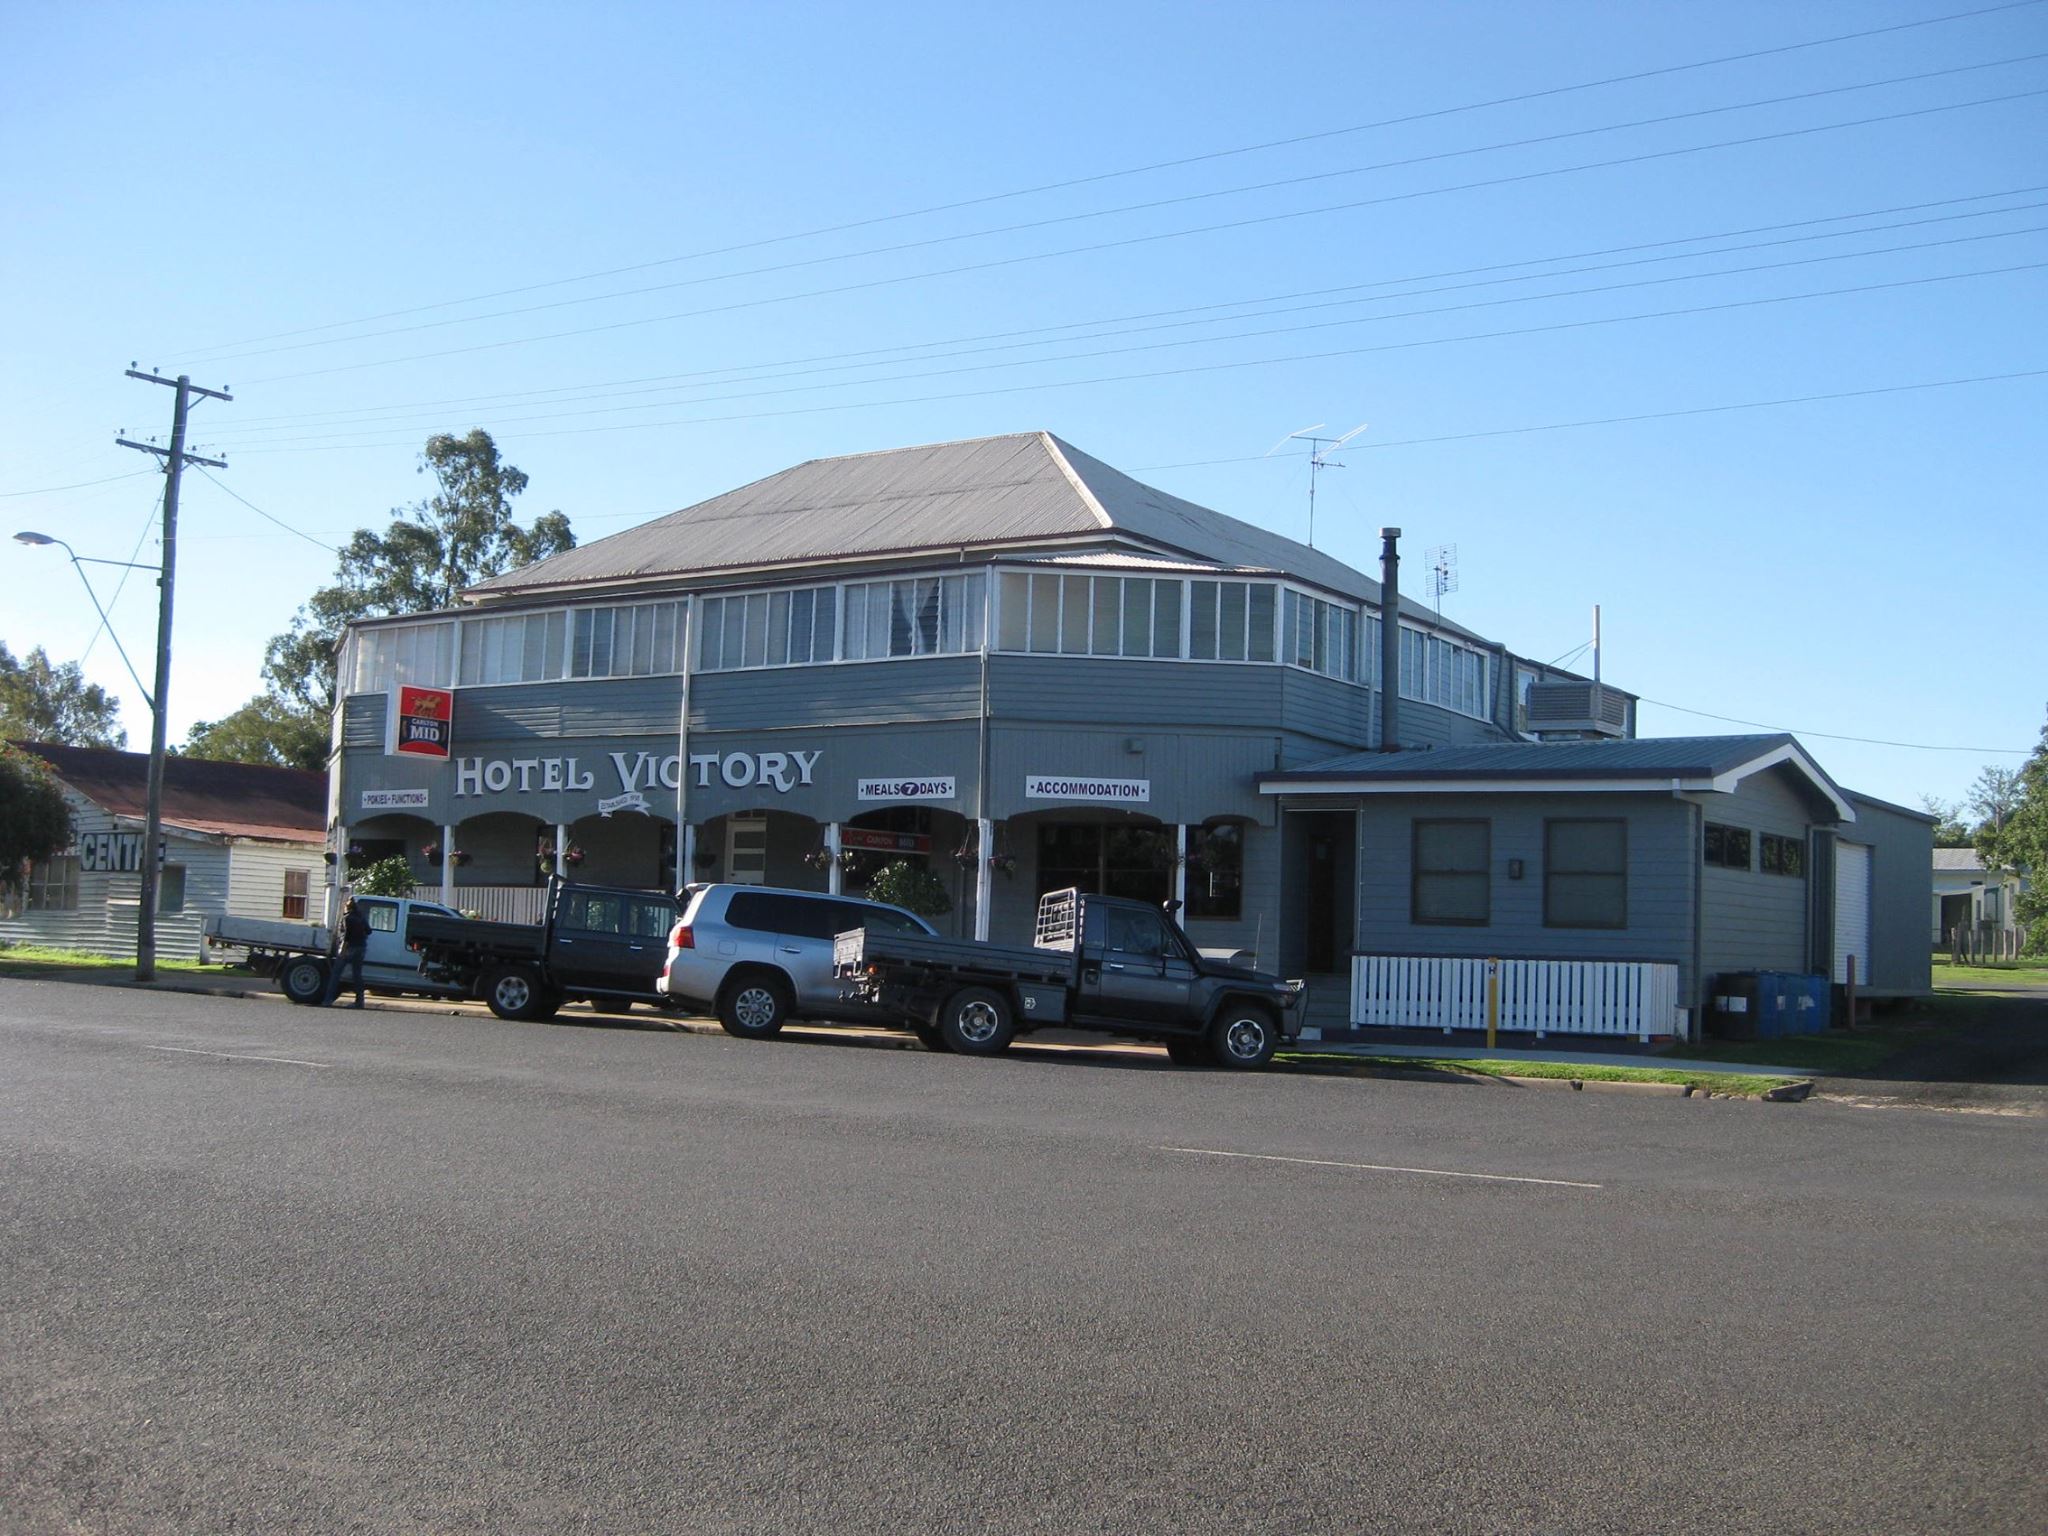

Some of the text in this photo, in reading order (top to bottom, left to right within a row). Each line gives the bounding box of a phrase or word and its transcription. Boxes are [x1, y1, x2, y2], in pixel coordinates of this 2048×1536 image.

[410, 725, 440, 741] MID
[454, 750, 824, 796] HOTEL VICTORY
[865, 782, 947, 796] MEALS 7 DAYS
[1036, 782, 1140, 797] ACCOMMODATION
